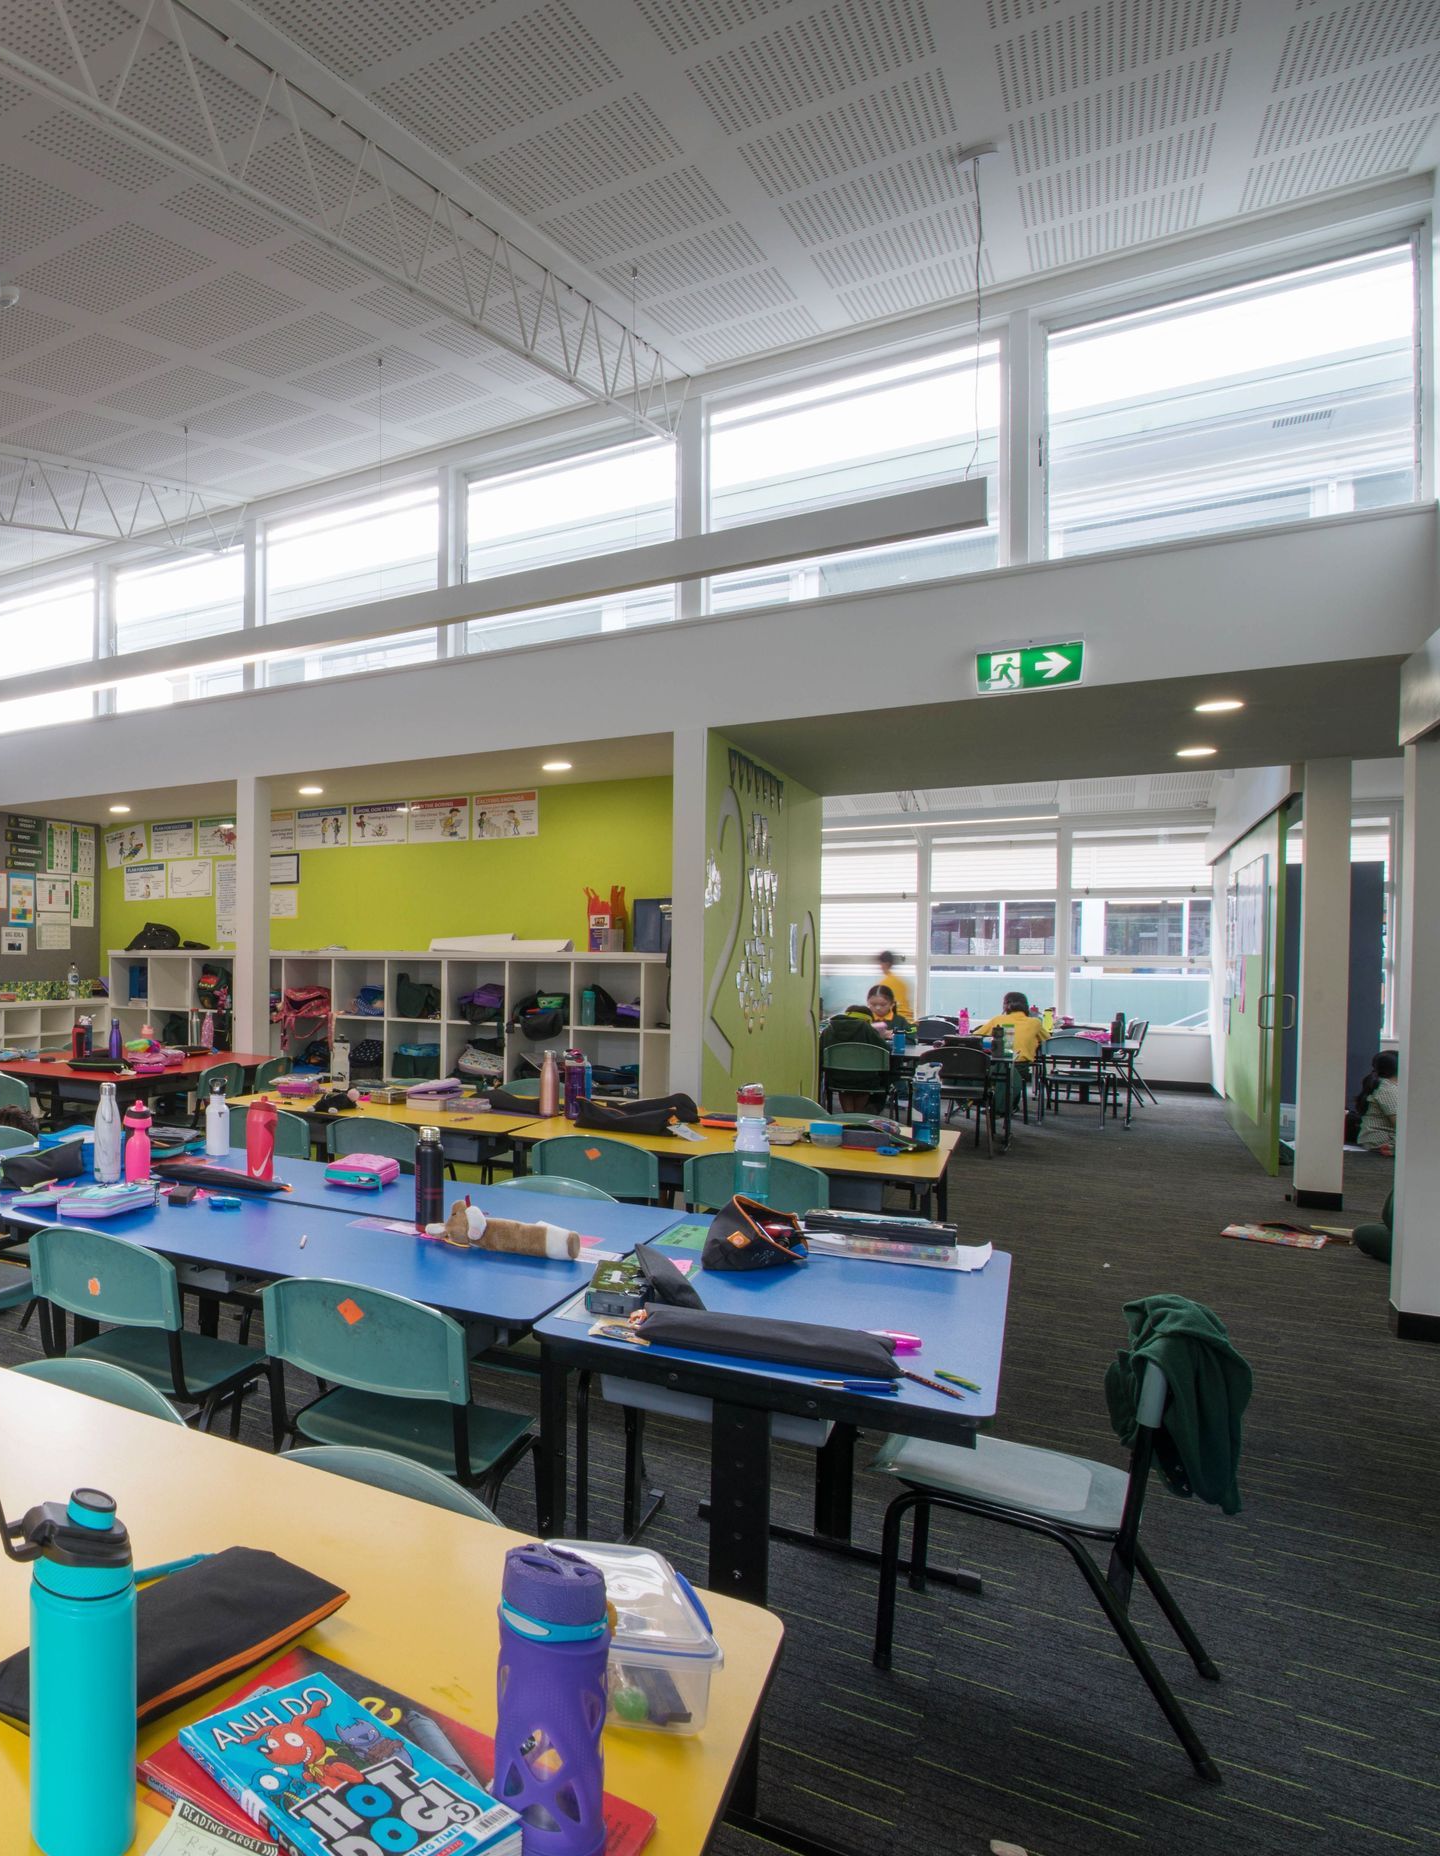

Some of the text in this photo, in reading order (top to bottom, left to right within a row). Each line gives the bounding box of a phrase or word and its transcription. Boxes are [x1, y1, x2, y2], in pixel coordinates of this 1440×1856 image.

[210, 1686, 334, 1751] ANH DO
[299, 1762, 416, 1835] HOT
[451, 1804, 470, 1821] 5
[182, 1804, 262, 1852] READING TARGET
